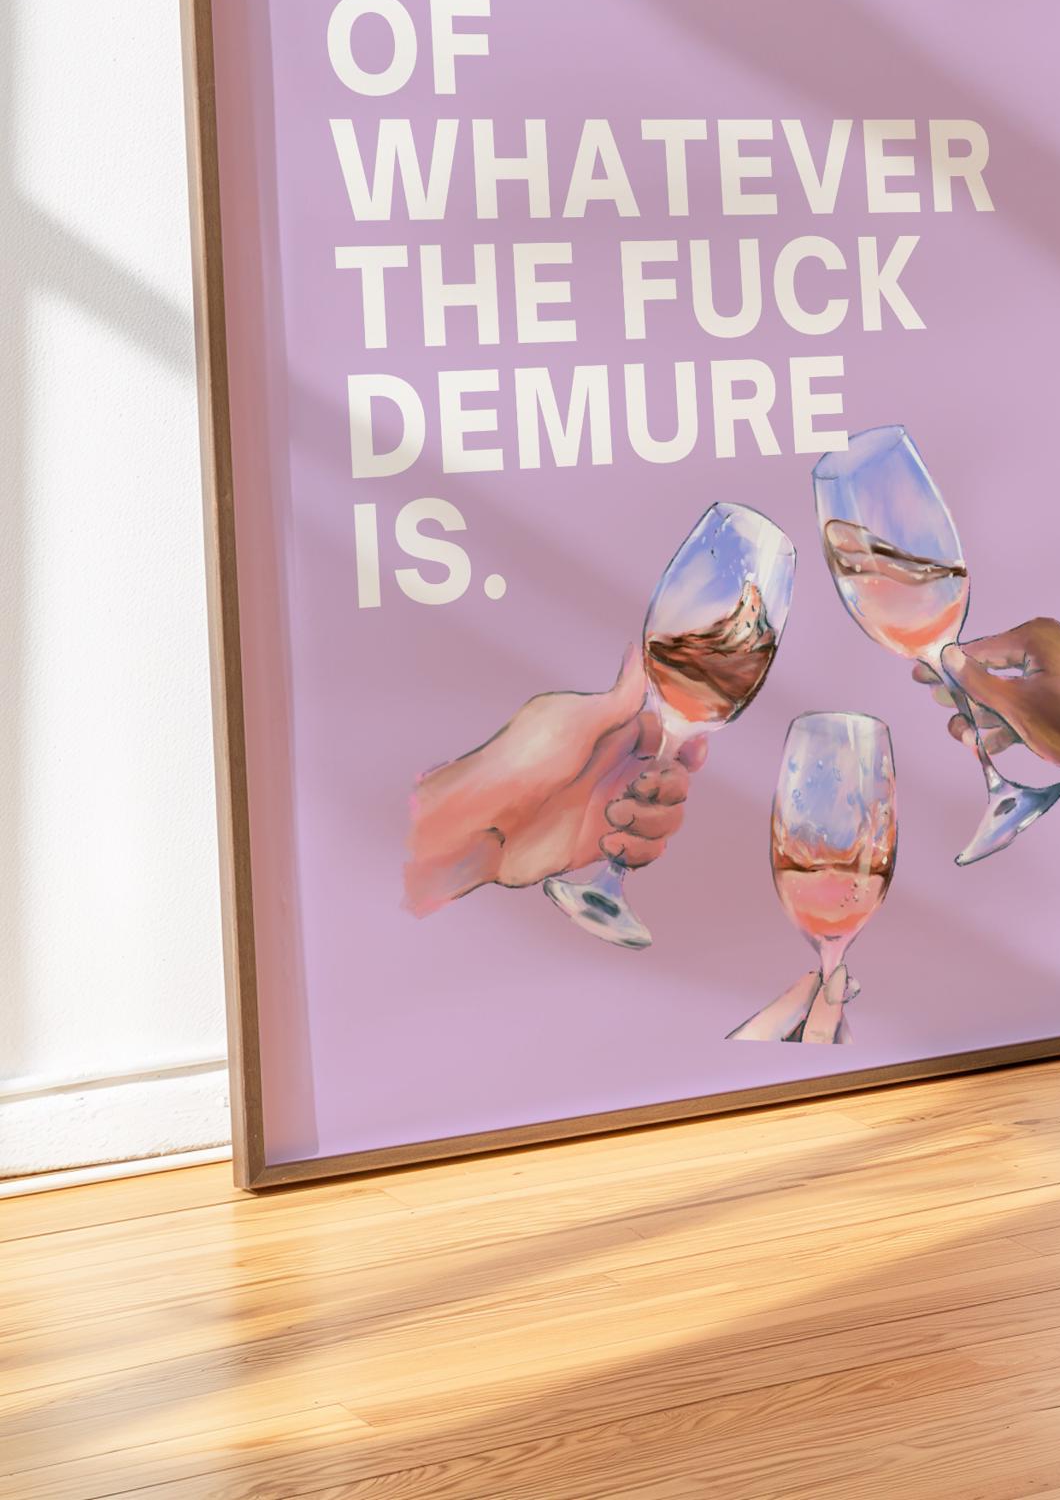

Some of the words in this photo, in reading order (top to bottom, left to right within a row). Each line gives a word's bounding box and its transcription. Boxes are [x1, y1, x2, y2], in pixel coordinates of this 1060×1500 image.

[328, 118, 996, 222] WHATEVER
[334, 241, 578, 349] THE
[618, 234, 926, 341] FUCK
[346, 355, 849, 480] DEMURE
[352, 496, 508, 610] IS.
